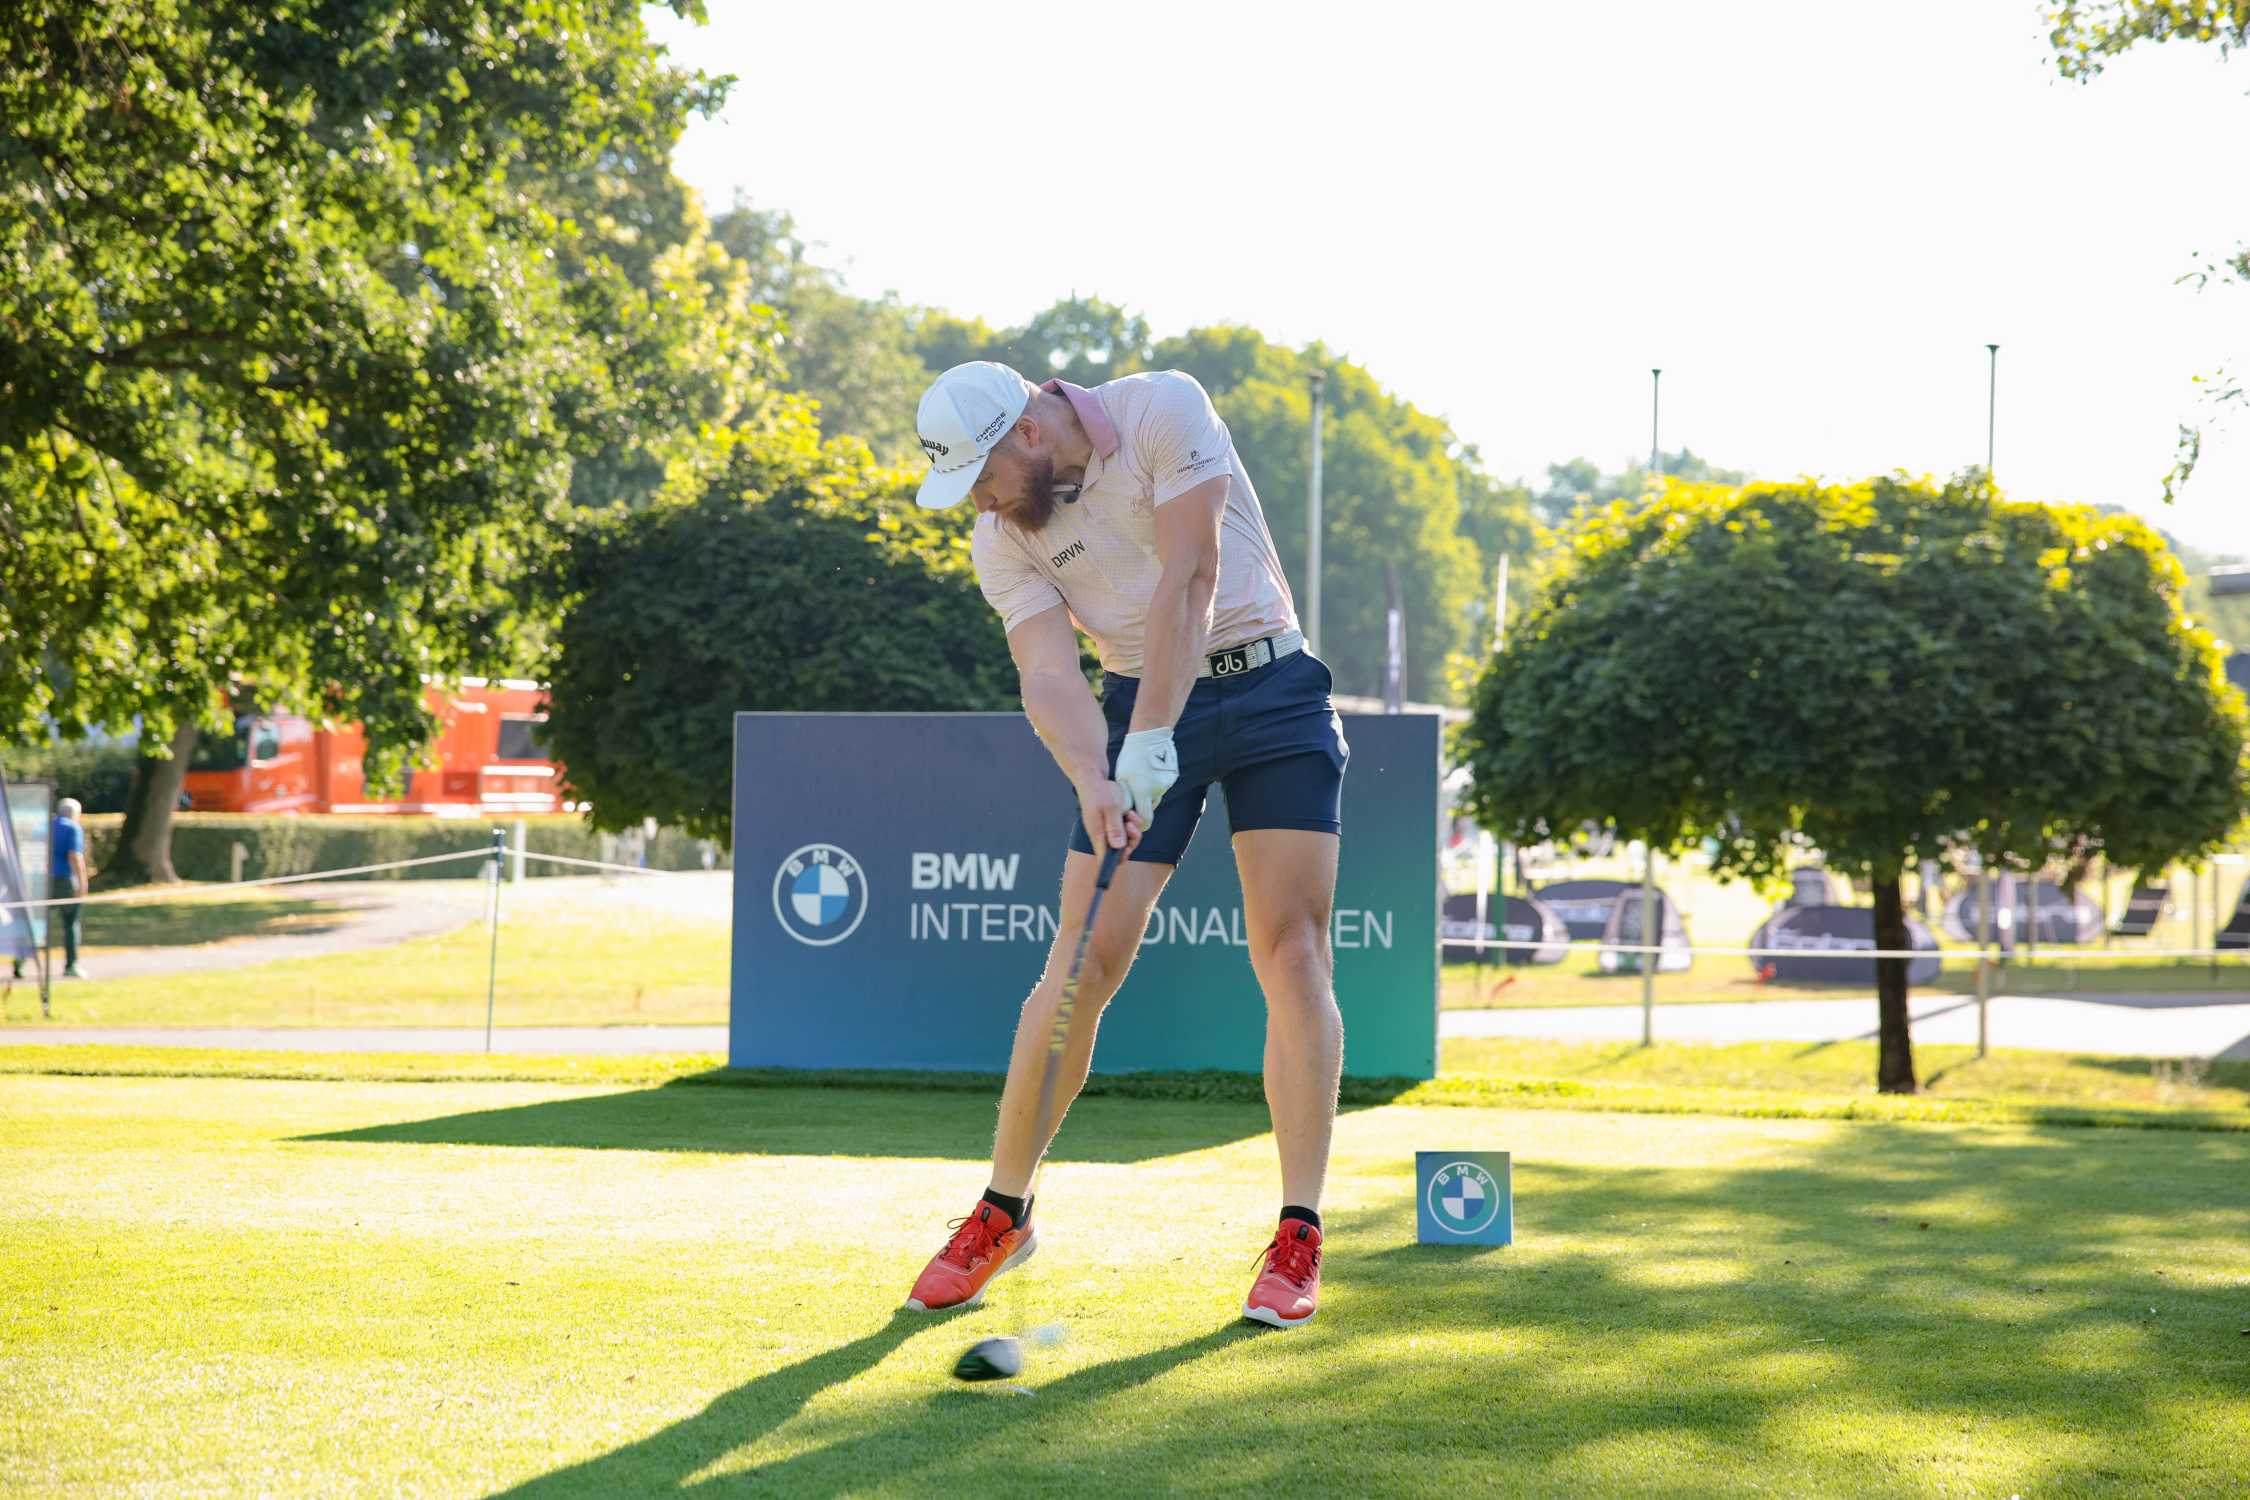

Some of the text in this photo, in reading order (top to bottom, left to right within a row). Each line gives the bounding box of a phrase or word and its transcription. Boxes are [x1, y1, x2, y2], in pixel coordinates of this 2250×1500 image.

[976, 411, 1006, 442] CHROME
[984, 420, 1005, 440] TOUR
[1051, 540, 1085, 568] DRVN
[786, 850, 856, 878] BMW
[911, 853, 1020, 891] BMW
[910, 902, 1249, 948] INTERNONAL
[1334, 909, 1393, 949] EN
[1438, 1166, 1489, 1186] BMW
